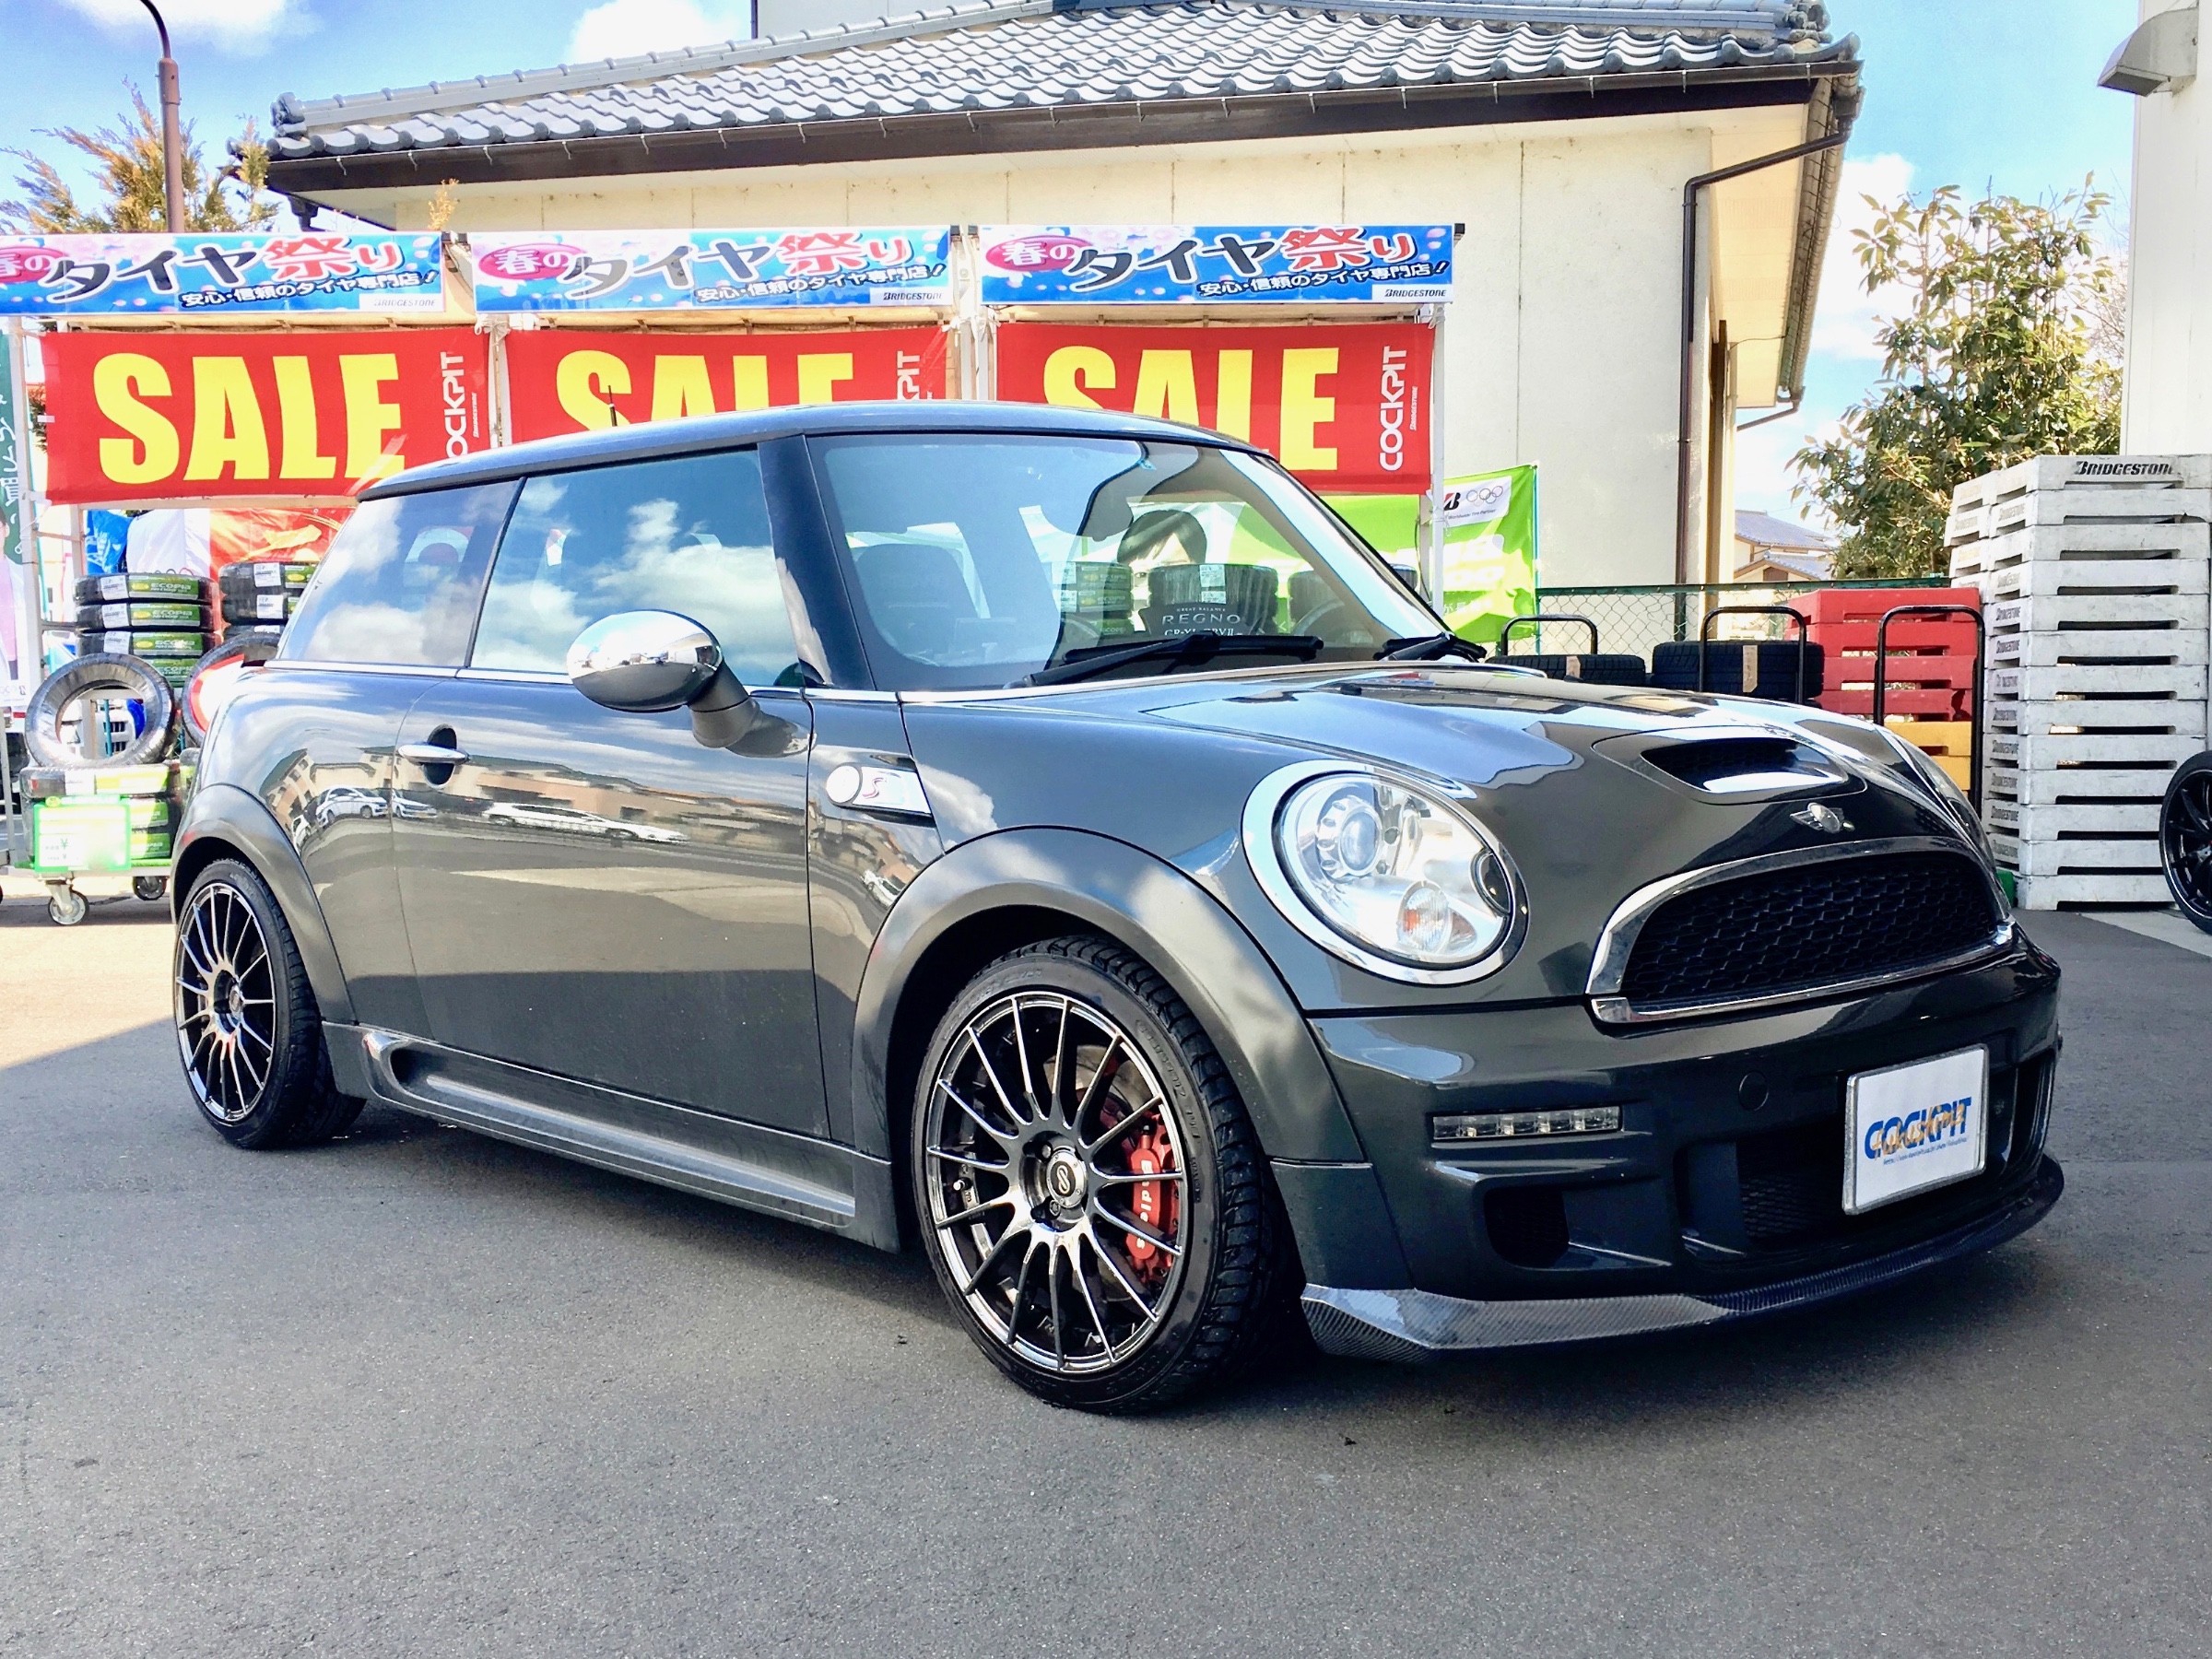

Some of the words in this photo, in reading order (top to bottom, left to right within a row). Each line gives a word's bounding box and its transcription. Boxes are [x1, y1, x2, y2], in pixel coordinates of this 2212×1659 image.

[882, 291, 944, 301] BRIDGESTONE
[1383, 288, 1447, 298] BRIDGESTONE
[373, 298, 436, 307] BRIDGESTONE
[1380, 346, 1407, 471] COCKPIT
[93, 352, 406, 484] SALE
[1161, 613, 1241, 626] REGNO
[1864, 1097, 1971, 1159] COCKPIT
